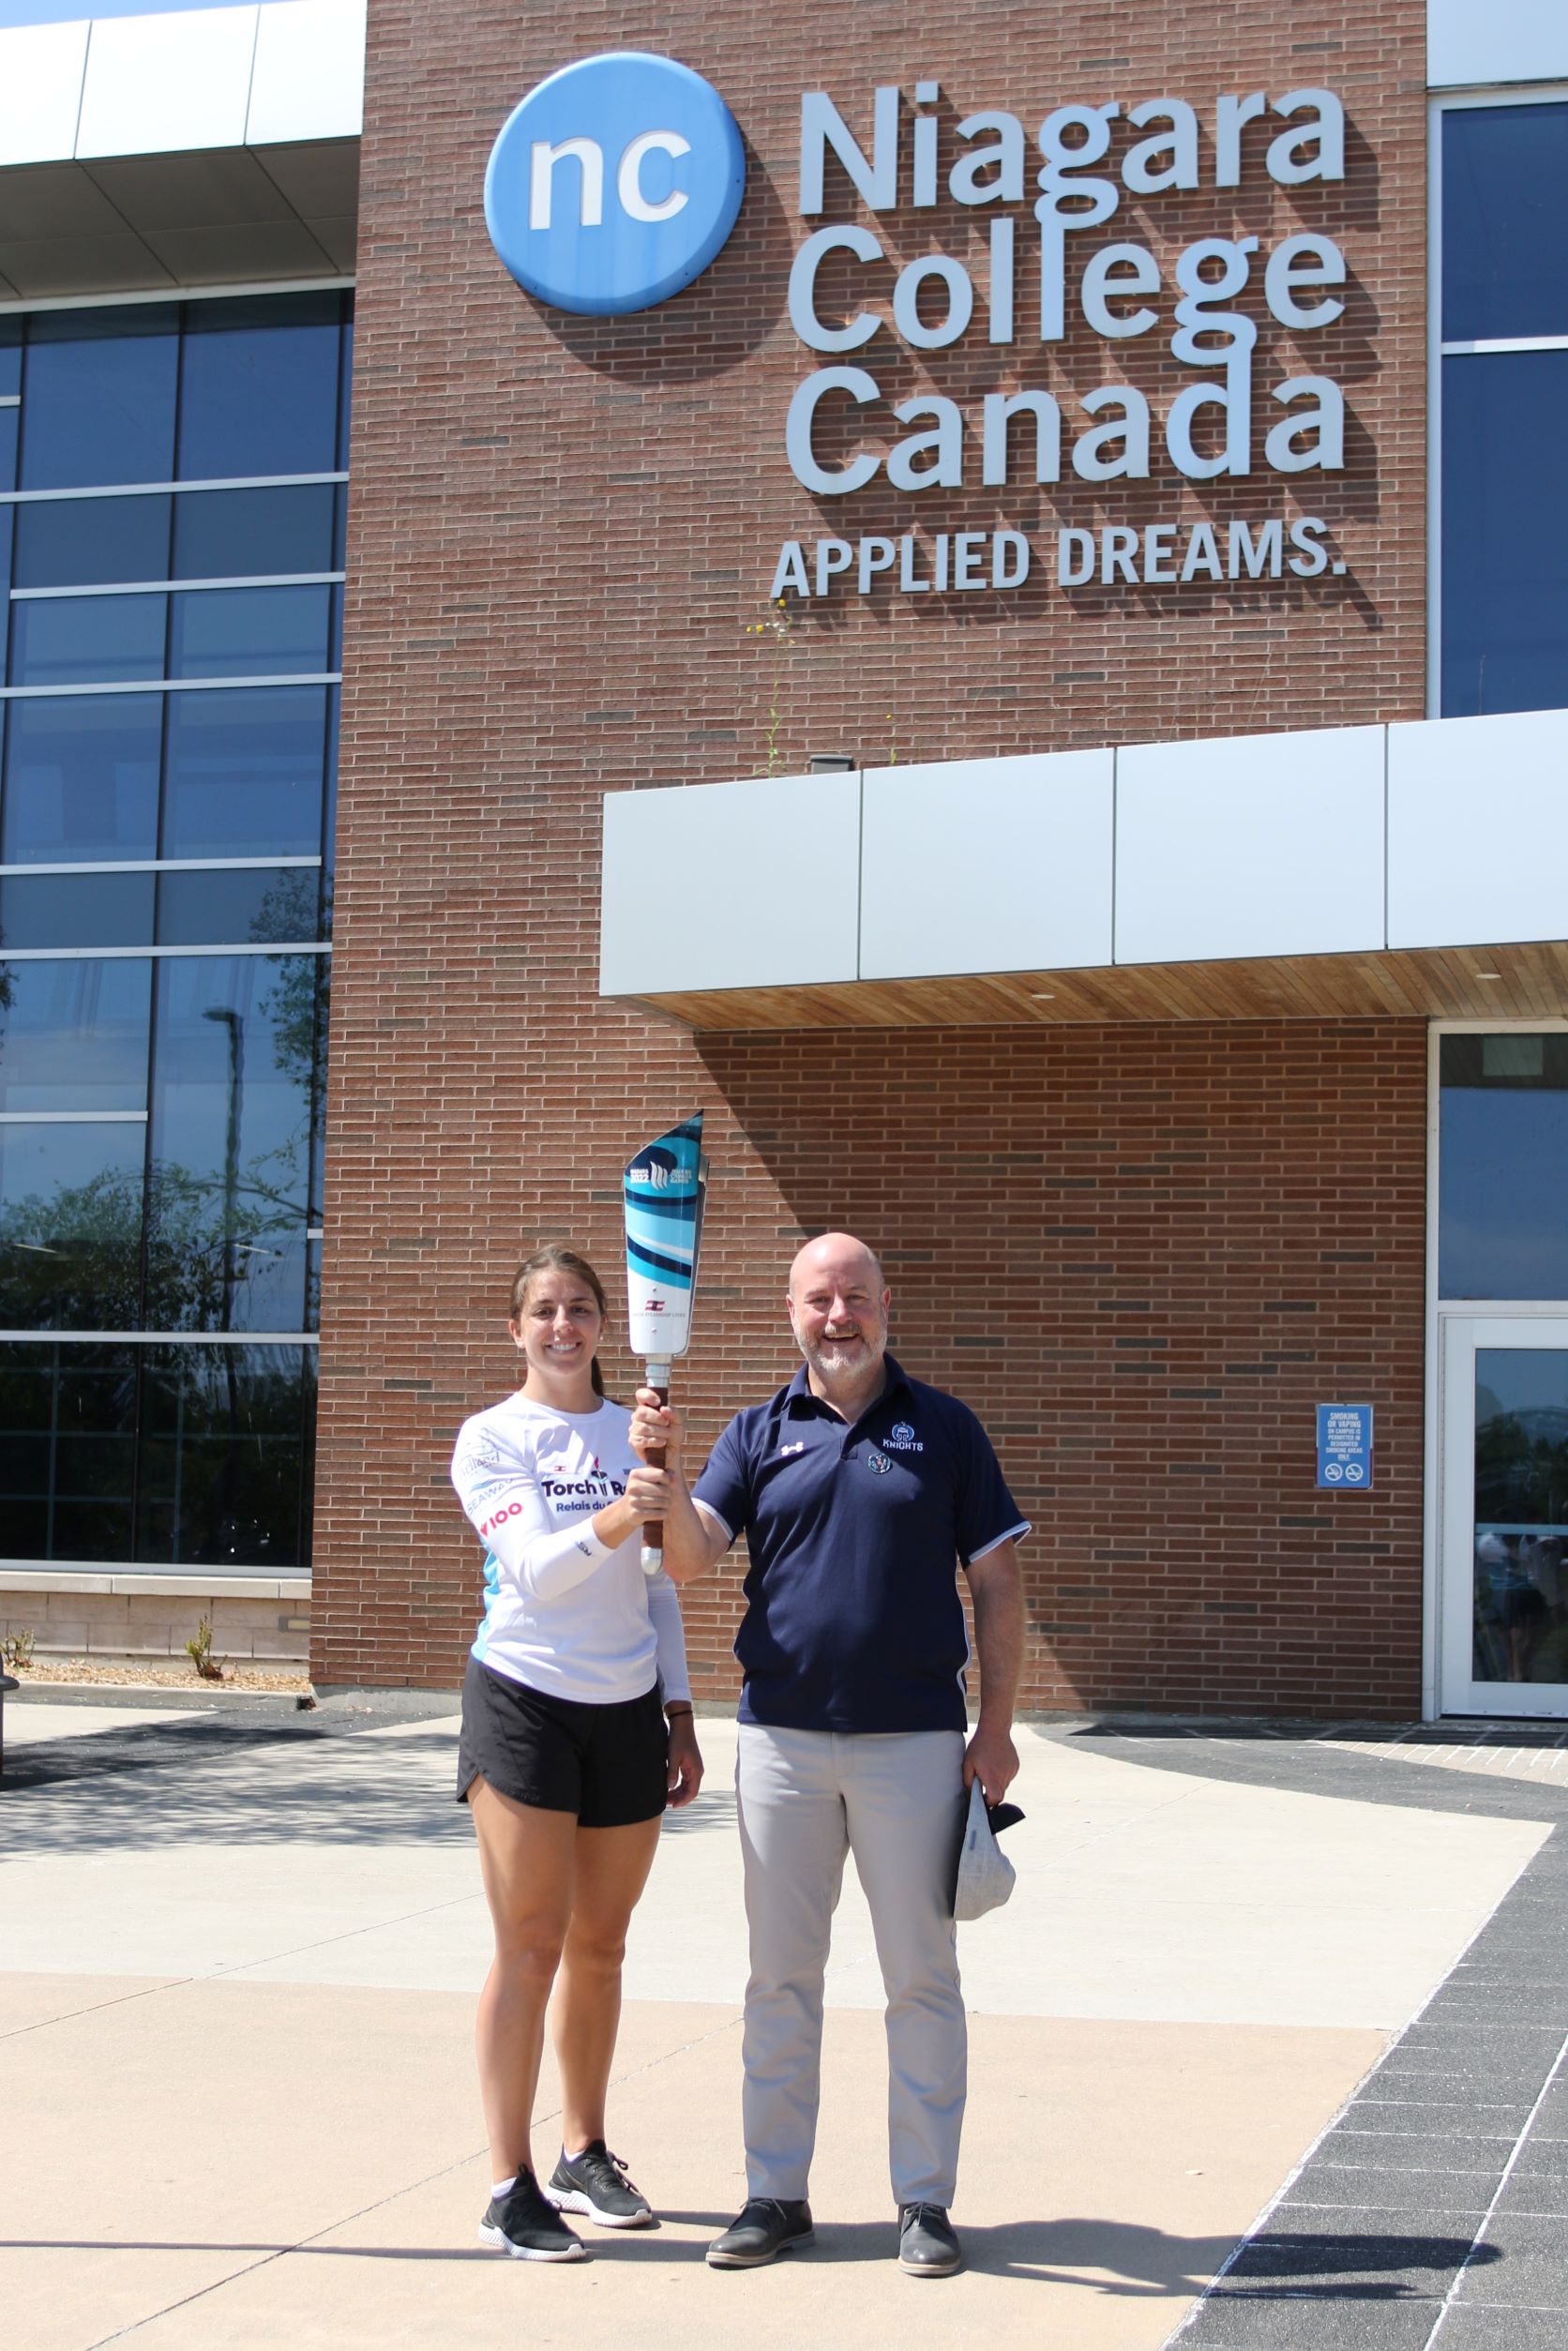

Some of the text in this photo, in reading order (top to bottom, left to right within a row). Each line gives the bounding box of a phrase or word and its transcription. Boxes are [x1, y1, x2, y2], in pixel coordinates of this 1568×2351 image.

[528, 130, 691, 231] nc
[799, 81, 1346, 229] Niagara
[787, 218, 1347, 367] College
[786, 364, 1346, 496] Canada
[771, 517, 1348, 599] APPLIED DREAMS.
[541, 1479, 597, 1497] Torch
[882, 1439, 924, 1452] KNIGHTS
[556, 1500, 591, 1513] Relais
[593, 1501, 606, 1511] du
